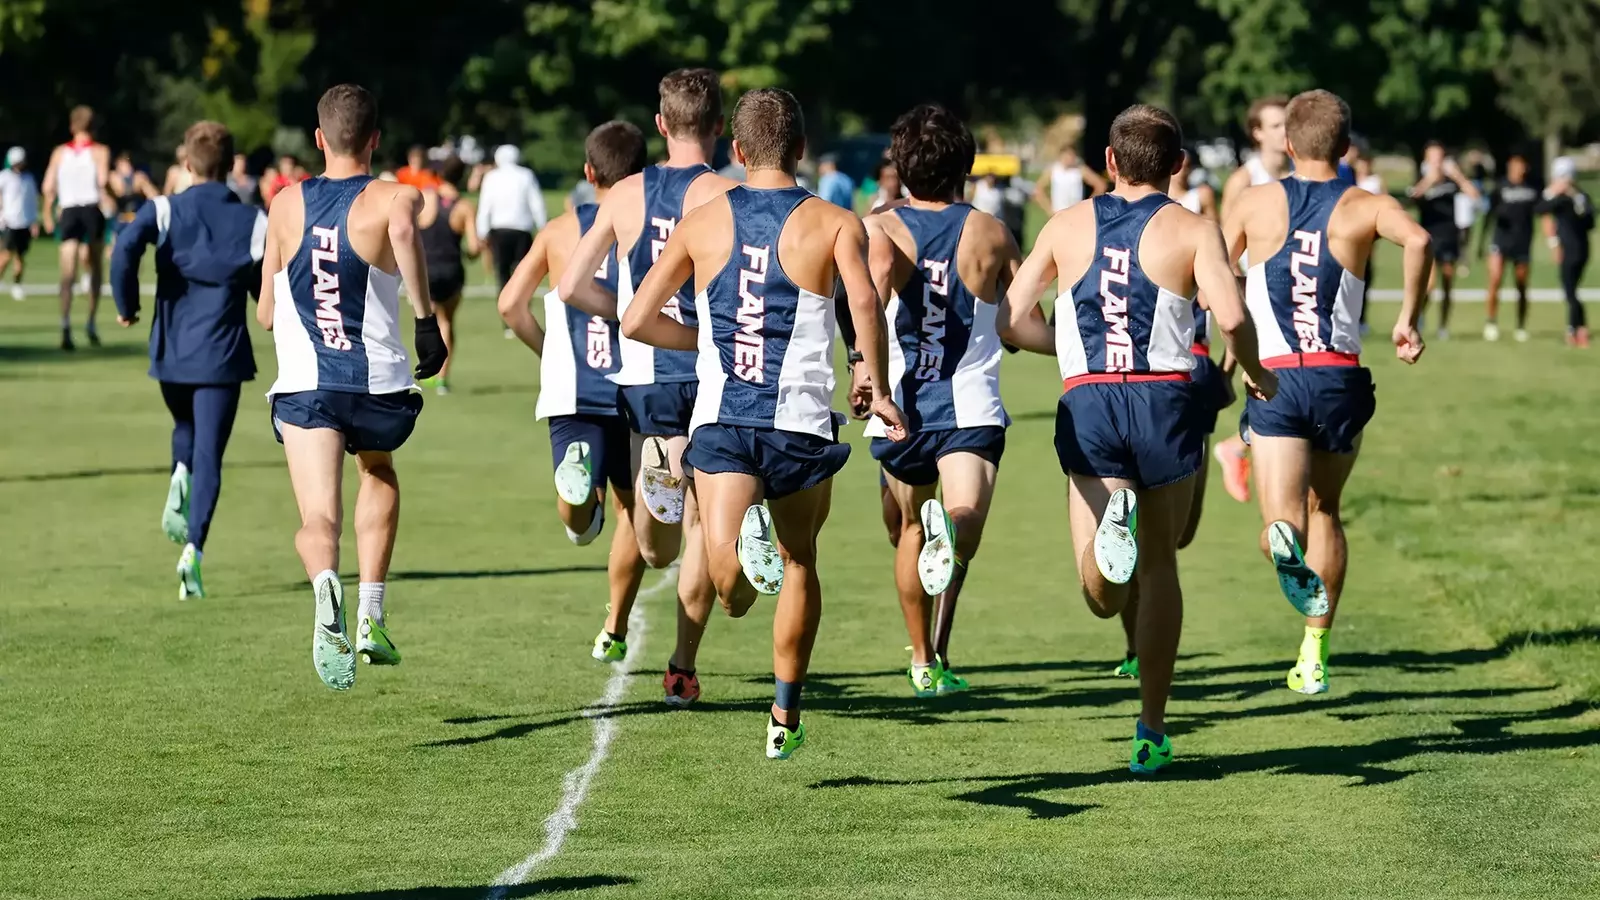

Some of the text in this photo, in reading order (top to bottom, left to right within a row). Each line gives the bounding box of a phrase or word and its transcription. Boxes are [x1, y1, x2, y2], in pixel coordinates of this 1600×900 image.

[312, 225, 352, 351] FLAMES
[733, 243, 770, 384] FLAMES
[915, 258, 949, 382] FLAMES
[1100, 247, 1134, 373] FLAME
[1290, 229, 1327, 353] FLAMES
